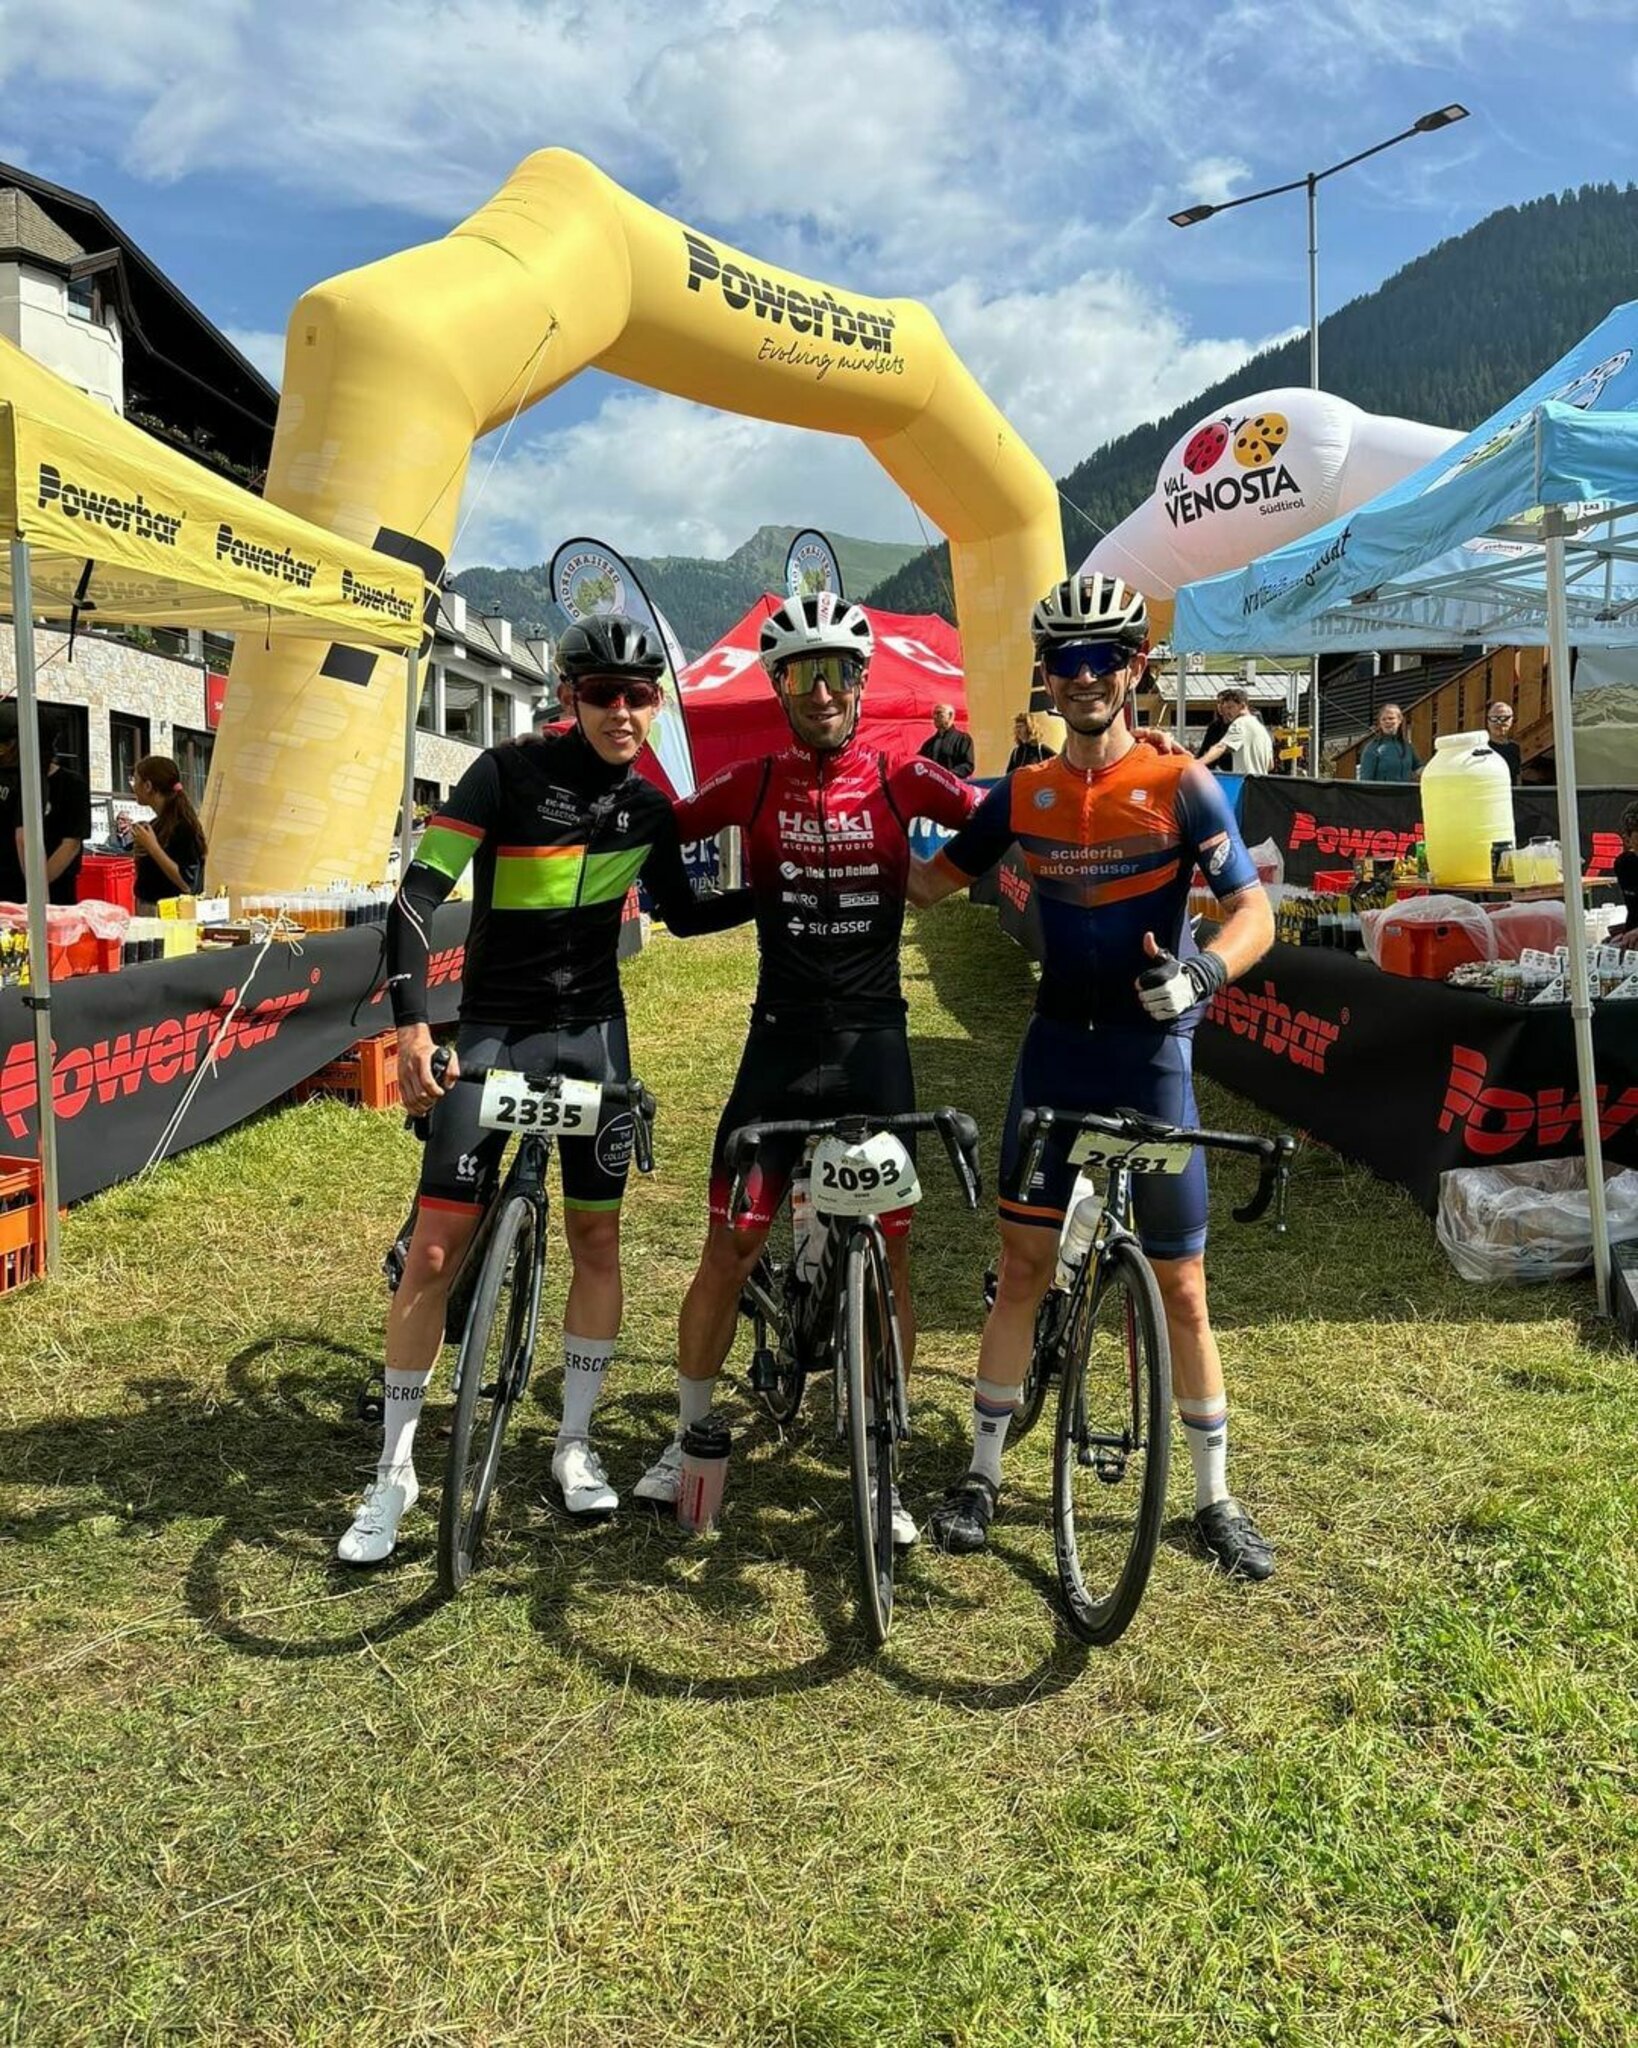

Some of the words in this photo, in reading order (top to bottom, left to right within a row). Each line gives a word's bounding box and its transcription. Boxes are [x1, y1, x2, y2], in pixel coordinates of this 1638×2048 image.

[683, 231, 895, 354] Powerbar
[757, 338, 834, 381] Evolving
[837, 349, 904, 375] mindsets
[1164, 473, 1188, 496] VAL
[1165, 464, 1301, 528] VENOSTA
[38, 463, 181, 546] Powerbar
[1259, 499, 1306, 516] Südtirol
[216, 524, 317, 588] Powerbar
[342, 569, 414, 622] Powerbar
[778, 810, 873, 833] Hackl
[1040, 863, 1139, 875] auto-neuser
[1051, 846, 1123, 860] scuderia
[496, 1096, 582, 1128] 2335
[823, 1159, 900, 1191] 2093
[1084, 1151, 1168, 1173] 2681
